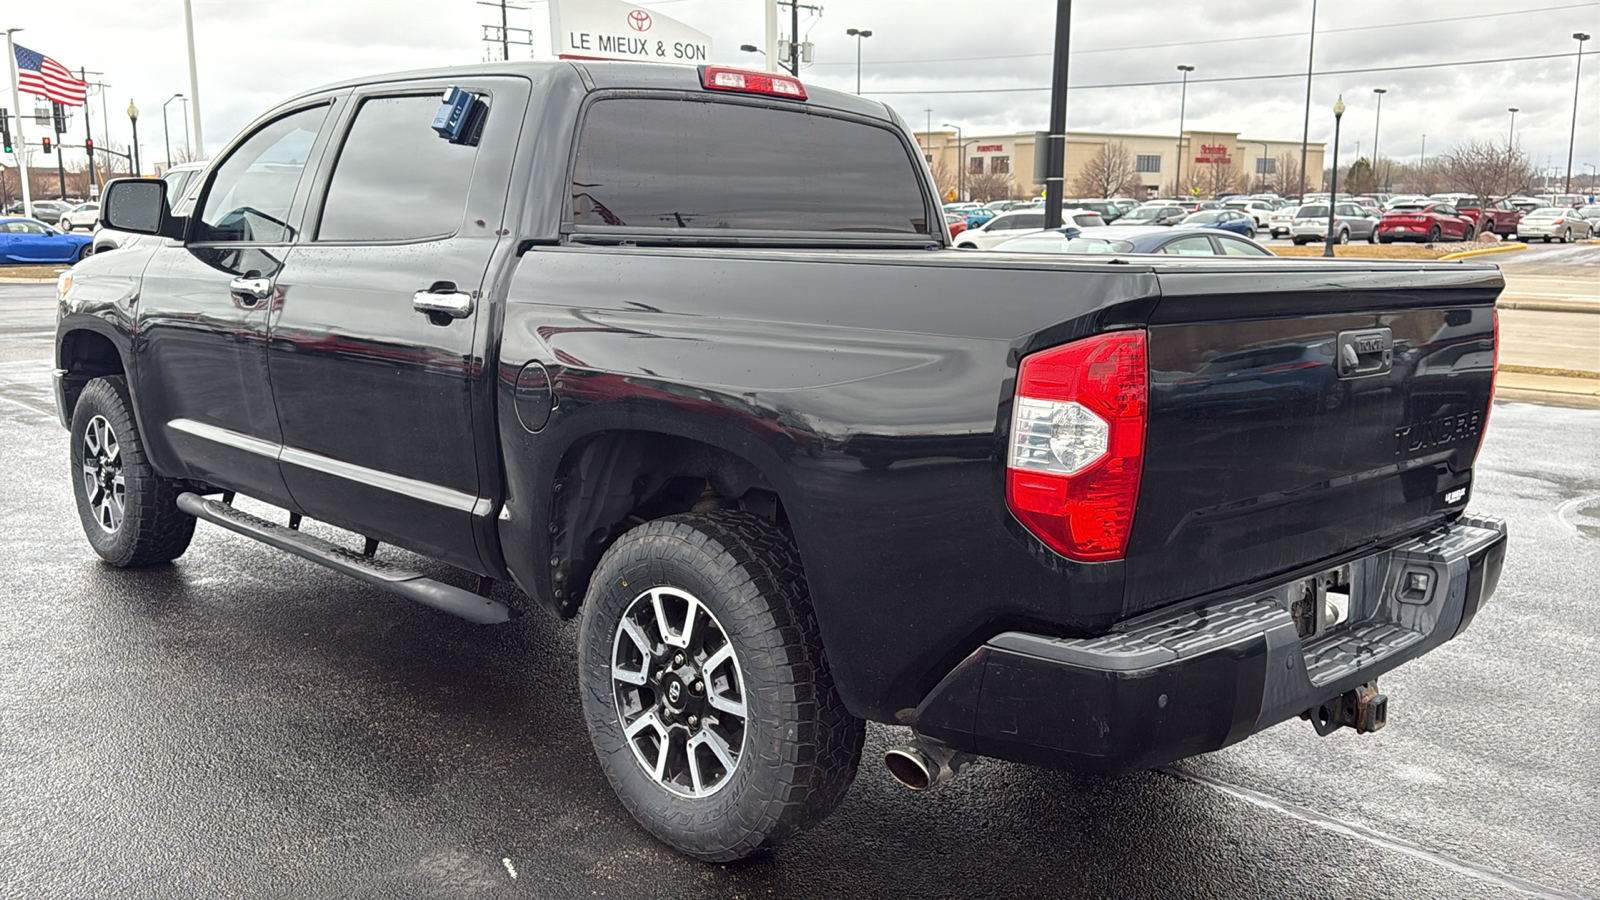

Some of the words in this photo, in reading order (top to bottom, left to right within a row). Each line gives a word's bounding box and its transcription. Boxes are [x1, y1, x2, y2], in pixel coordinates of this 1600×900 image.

[570, 32, 591, 50] LE
[598, 35, 649, 56] MIEUX
[655, 41, 667, 57] &
[674, 42, 706, 60] SON
[1395, 410, 1480, 455] TUNDRA
